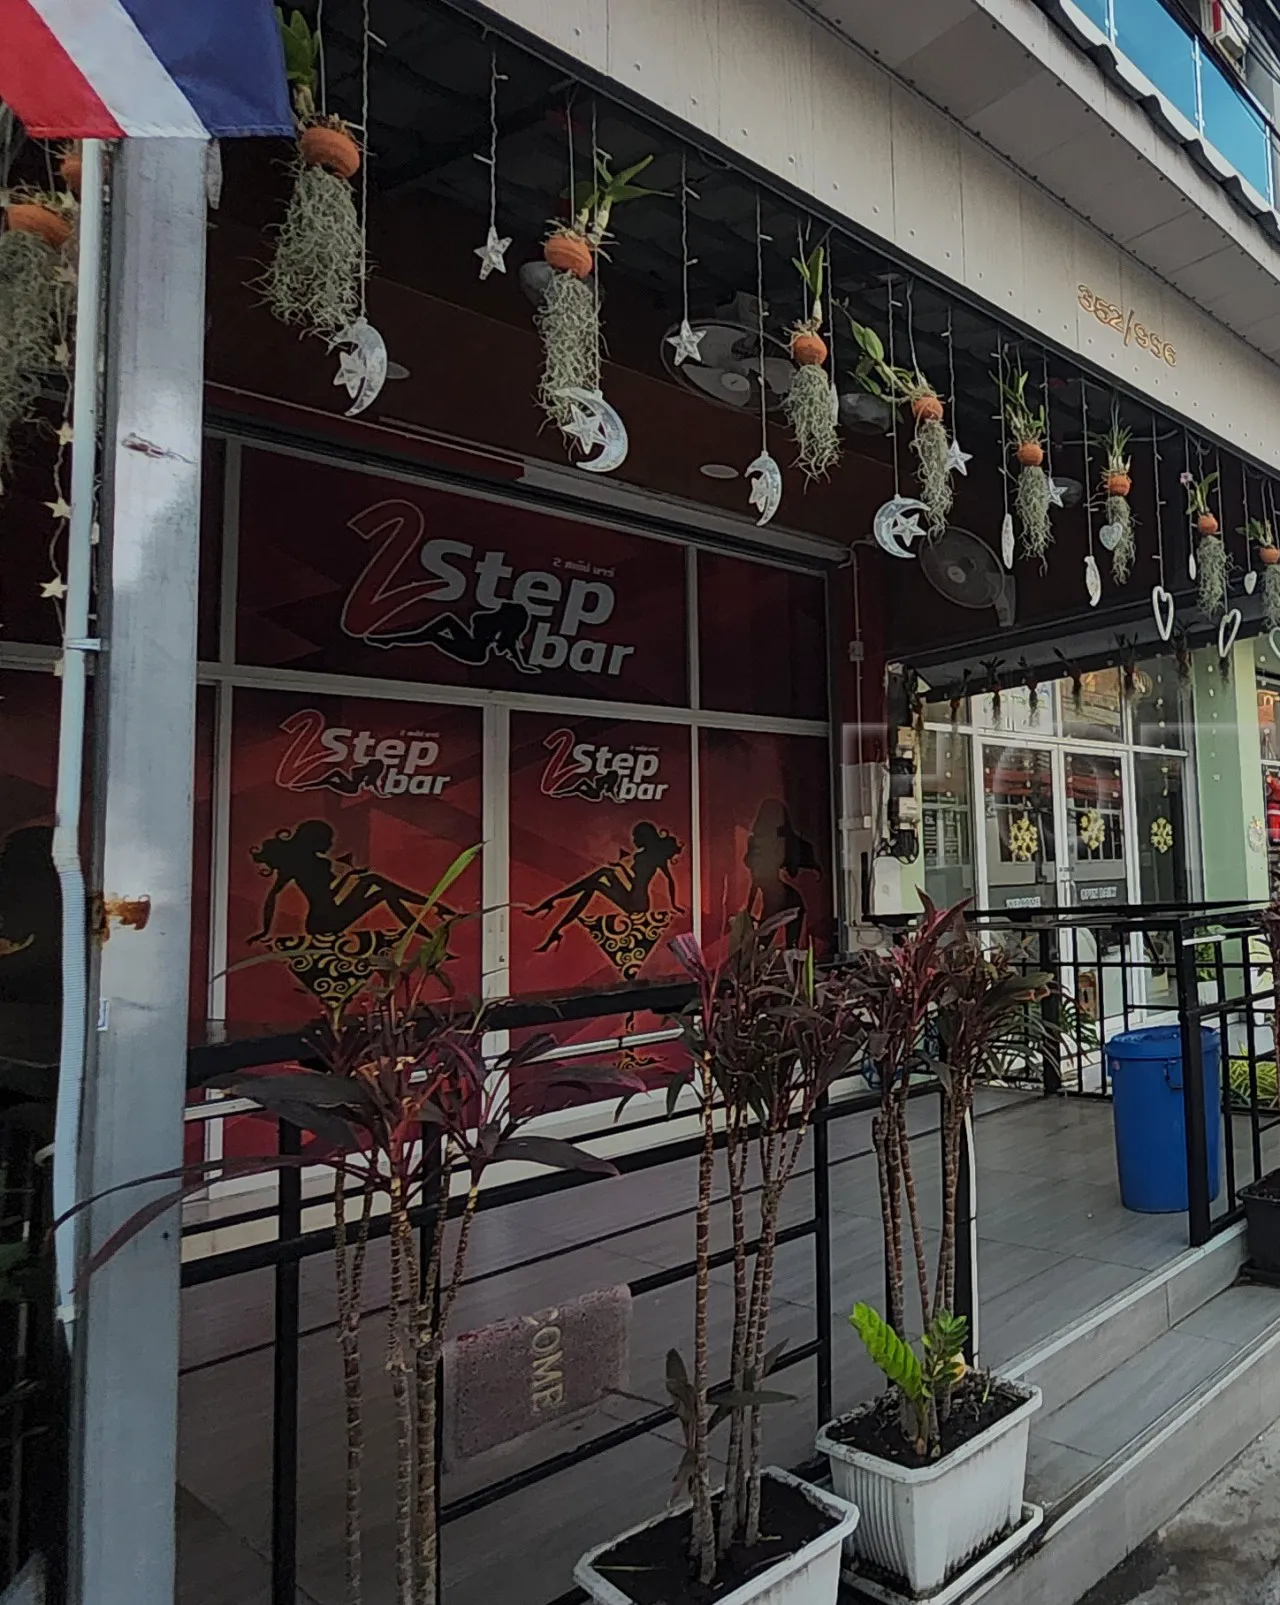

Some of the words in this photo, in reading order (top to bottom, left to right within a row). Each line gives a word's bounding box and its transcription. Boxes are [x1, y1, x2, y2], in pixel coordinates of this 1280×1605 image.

[341, 499, 448, 637] 2
[420, 538, 615, 636] Step
[529, 622, 634, 675] bar
[275, 709, 341, 789] 2
[320, 728, 440, 775] Step
[540, 728, 584, 796] 2
[570, 744, 661, 783] Step
[384, 769, 451, 796] bar
[619, 779, 670, 801] bar
